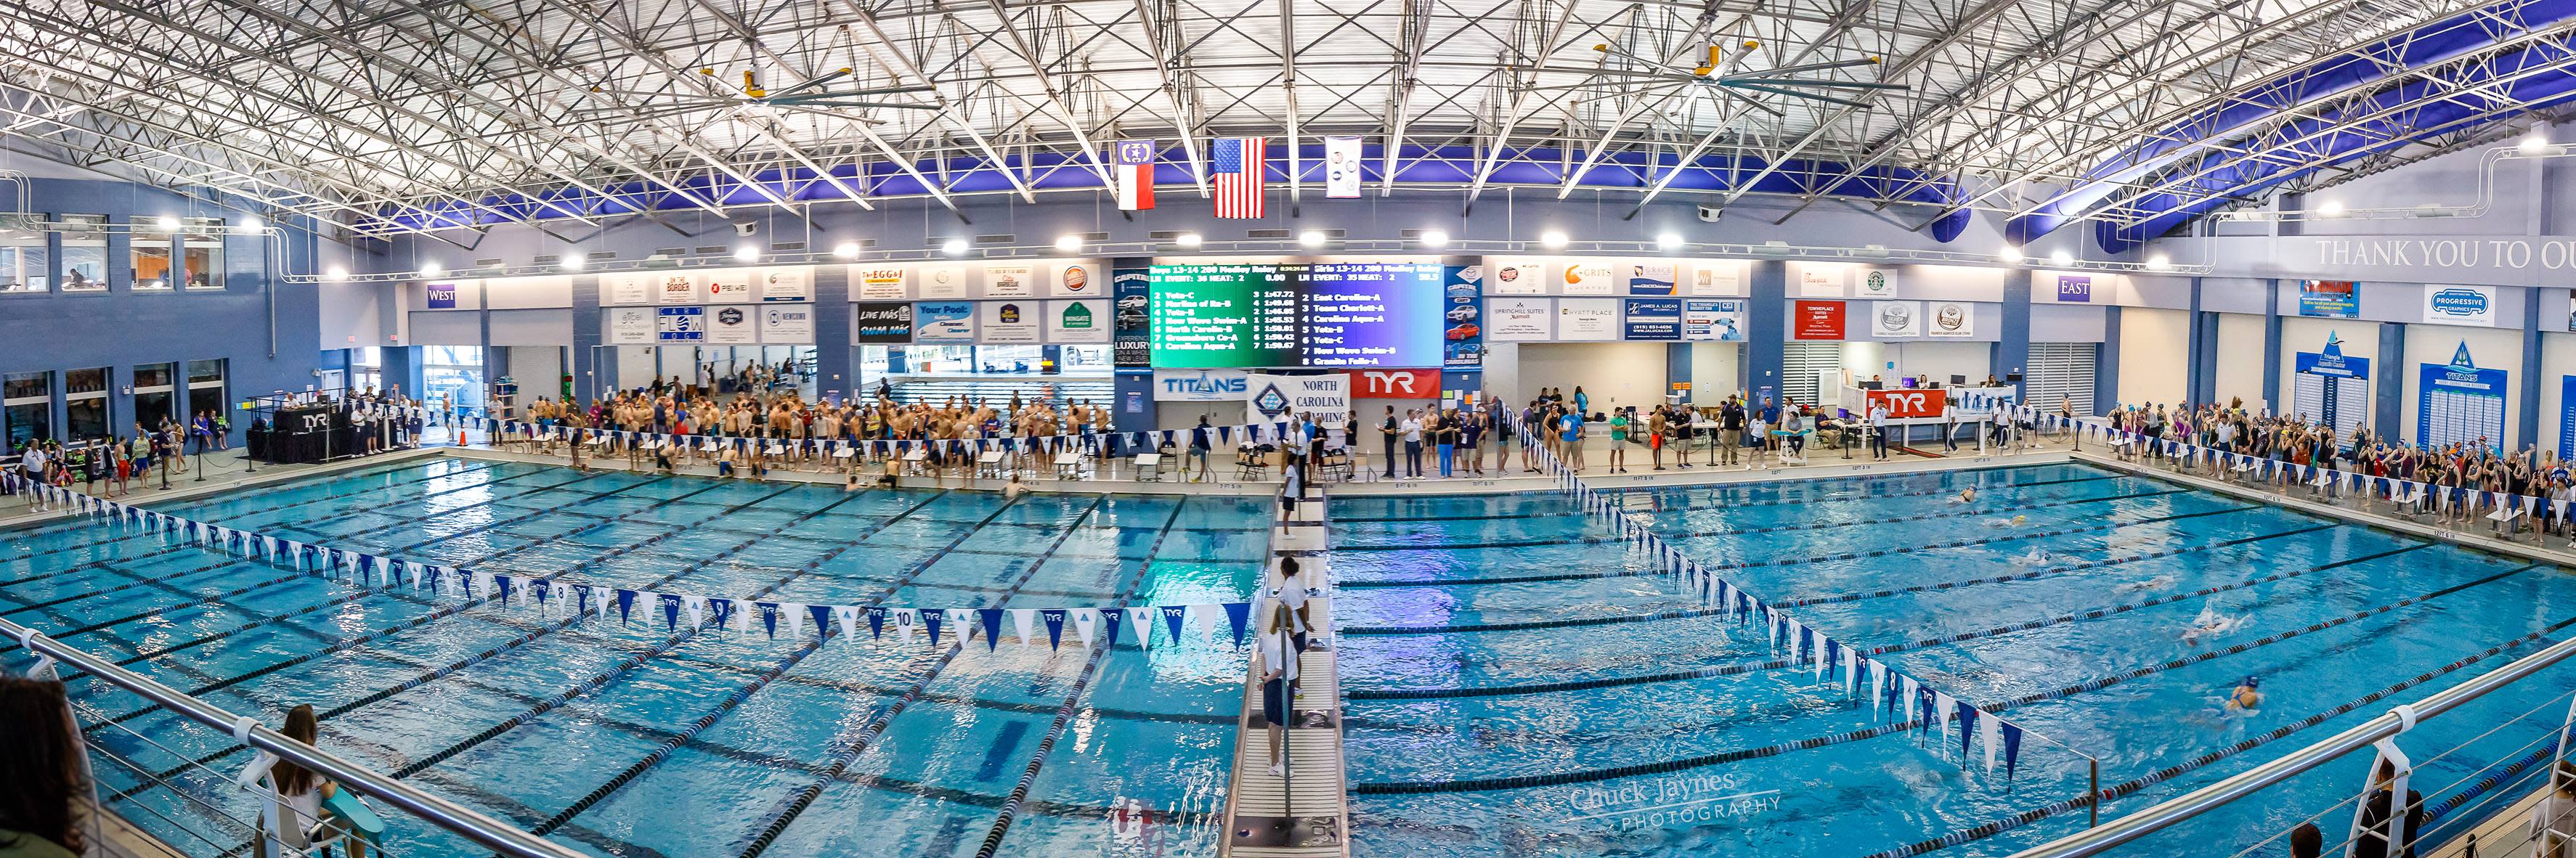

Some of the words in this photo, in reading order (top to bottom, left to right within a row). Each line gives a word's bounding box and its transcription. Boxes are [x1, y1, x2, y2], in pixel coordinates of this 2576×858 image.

[2315, 240, 2413, 267] THANK
[2418, 240, 2481, 268] YOU
[2489, 240, 2531, 269] TO
[1417, 265, 1441, 274] Relay
[667, 282, 690, 292] BORDER
[2061, 280, 2090, 295] EAST
[428, 290, 455, 301] WEST
[1163, 372, 1247, 394] TITANS
[1364, 372, 1415, 393] TYR
[2446, 372, 2478, 382] TITANS
[1302, 380, 1337, 392] NORTH
[1296, 396, 1344, 408] CAROLINA
[1885, 393, 1926, 413] TYR
[302, 413, 328, 428] TYR
[558, 587, 564, 599] 8
[664, 598, 678, 607] TYR
[716, 602, 723, 616] 9
[868, 608, 882, 617] TYR
[897, 612, 911, 626] 10
[924, 612, 940, 621] TYR
[1045, 613, 1062, 622] TYR
[1164, 608, 1182, 617] TYR
[1770, 613, 1775, 628] 7
[1856, 655, 1866, 669] TYR
[1890, 671, 1896, 690] 8
[1922, 690, 1933, 704] TYR
